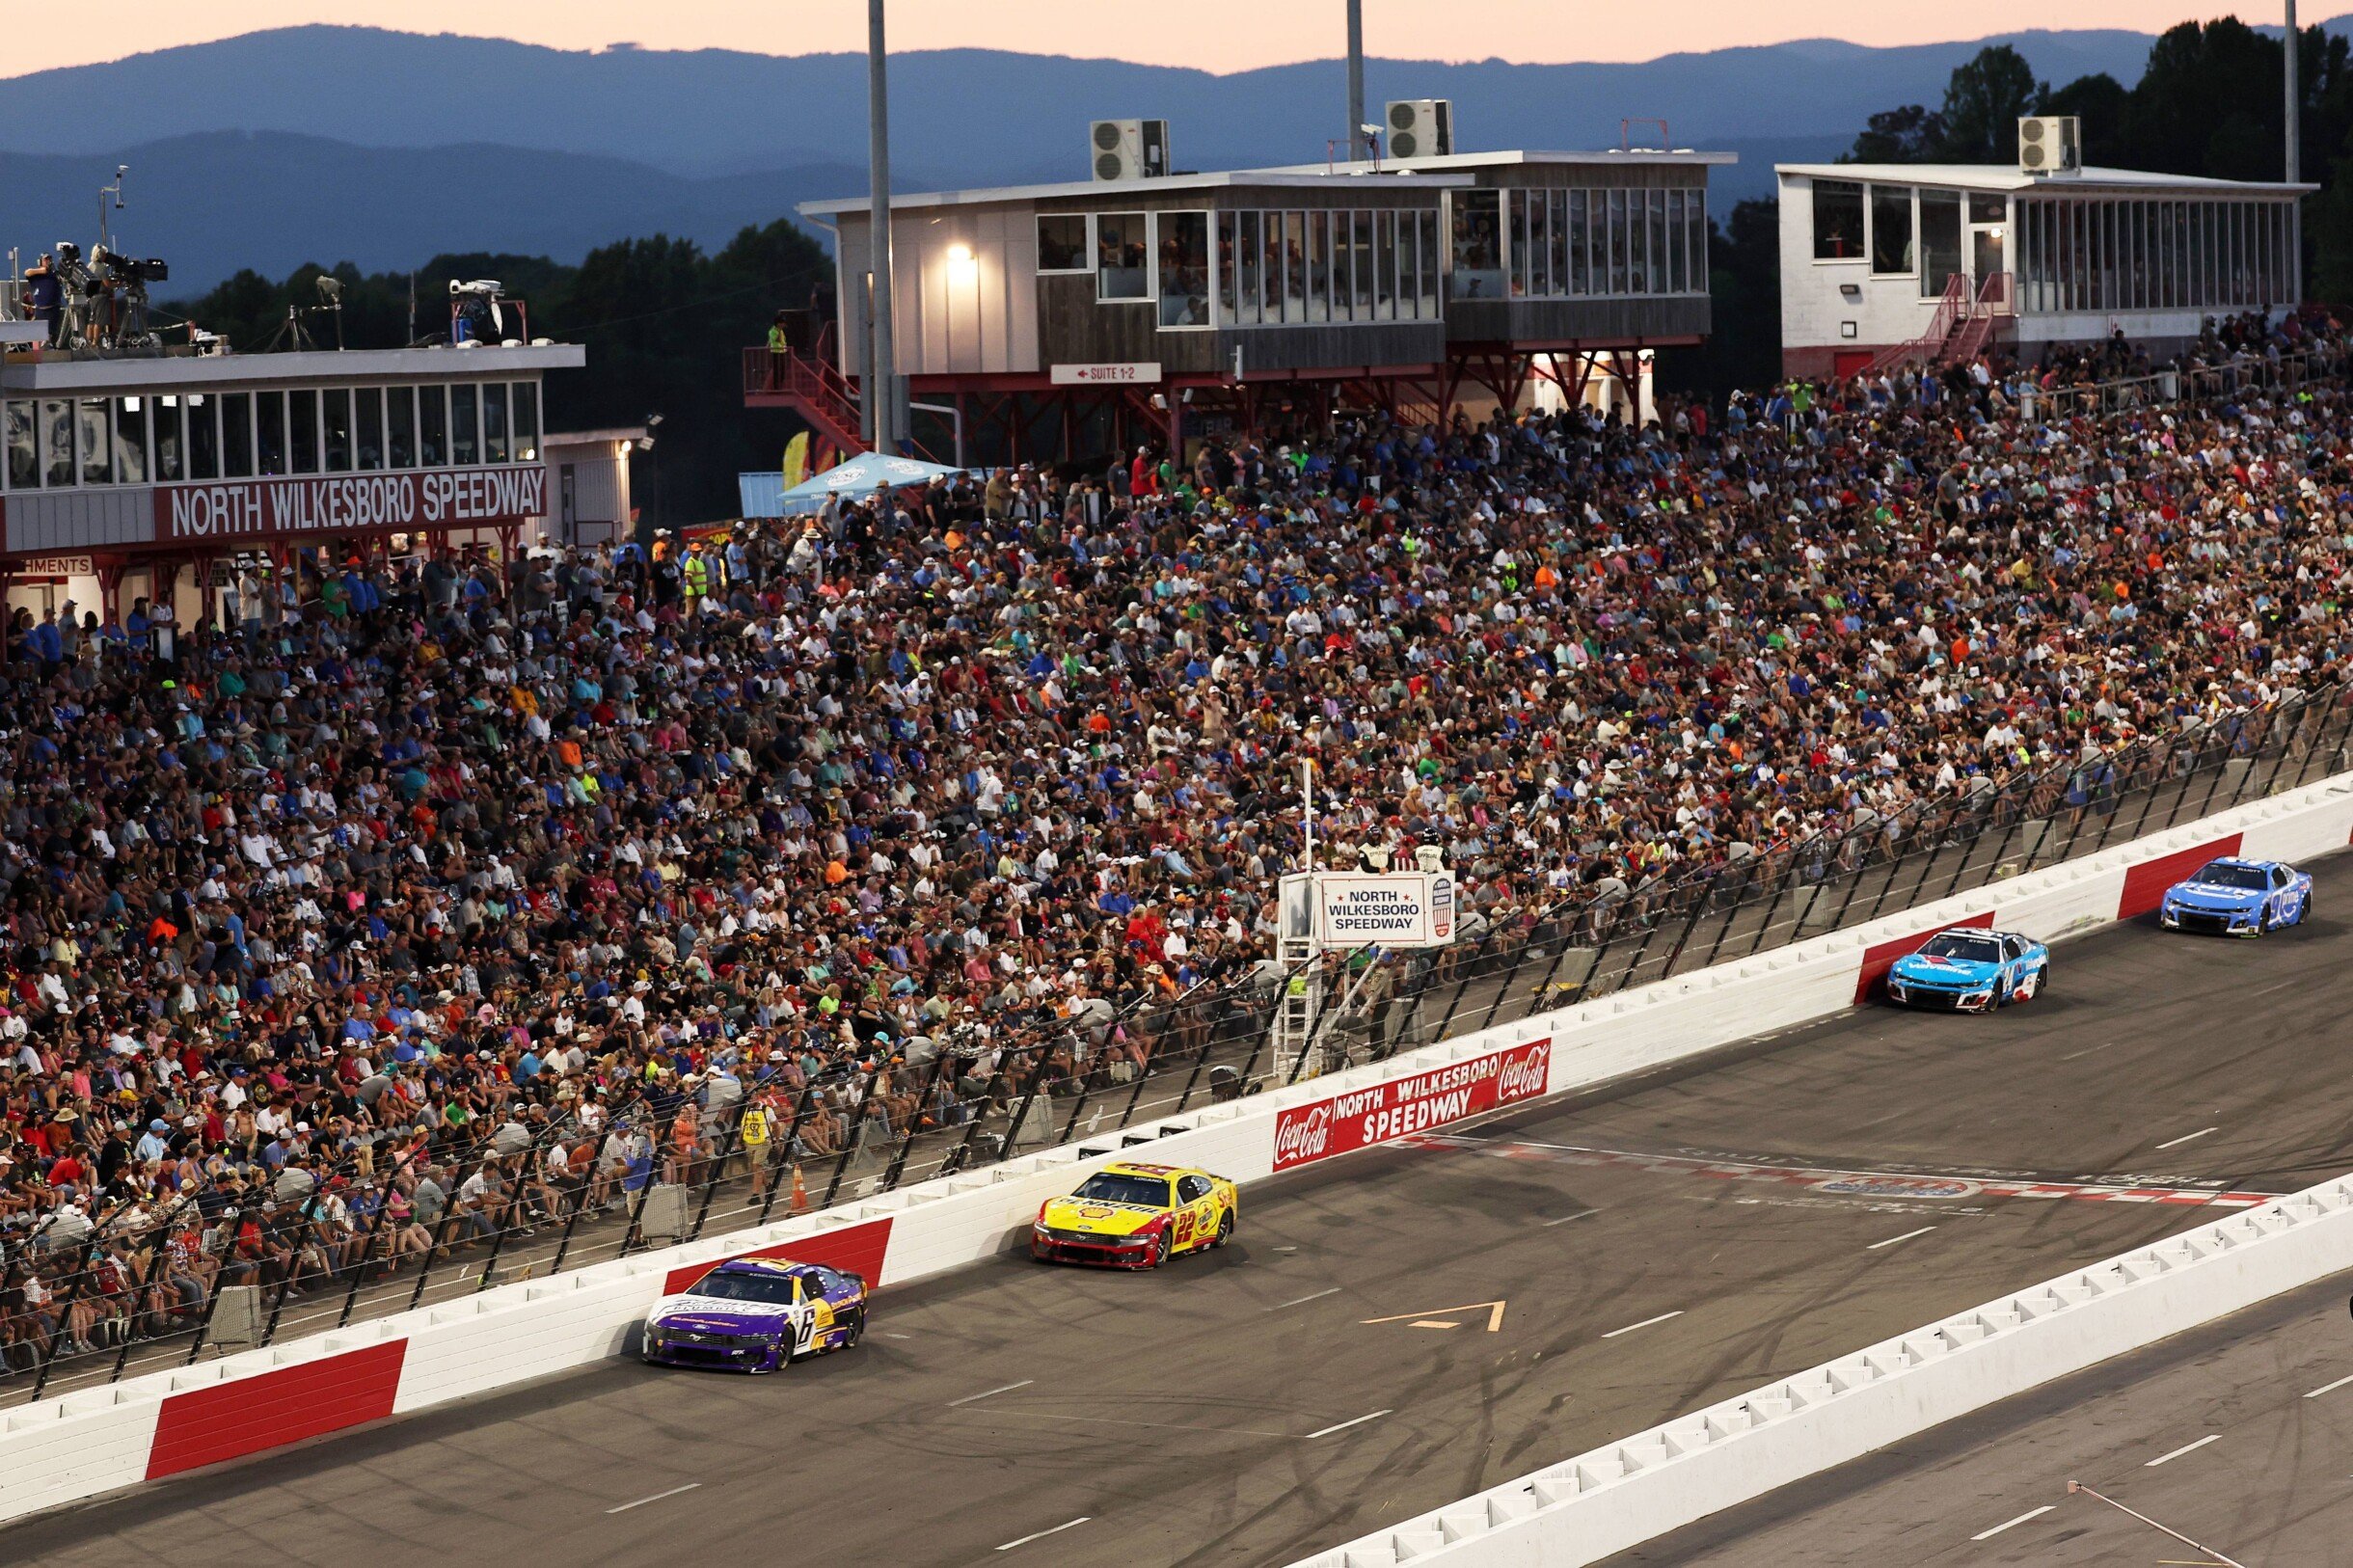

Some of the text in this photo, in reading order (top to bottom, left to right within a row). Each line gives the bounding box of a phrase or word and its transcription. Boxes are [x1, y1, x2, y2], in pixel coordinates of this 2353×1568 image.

[1091, 366, 1135, 380] SUITE 1-2
[172, 468, 545, 537] NORTH WILKESBORO SPEEDWAY
[1329, 904, 1420, 916] WILKESBORO
[1349, 891, 1397, 903] NORTH
[1335, 917, 1413, 930] SPEEDWAY
[1336, 1055, 1498, 1120] NORTH WILKESBORO
[1497, 1043, 1550, 1101] Coca-Cola
[1274, 1105, 1333, 1164] Coca-Cola
[1362, 1088, 1474, 1145] SPEEDWAY
[1175, 1210, 1197, 1245] 22
[797, 1307, 816, 1349] 6
